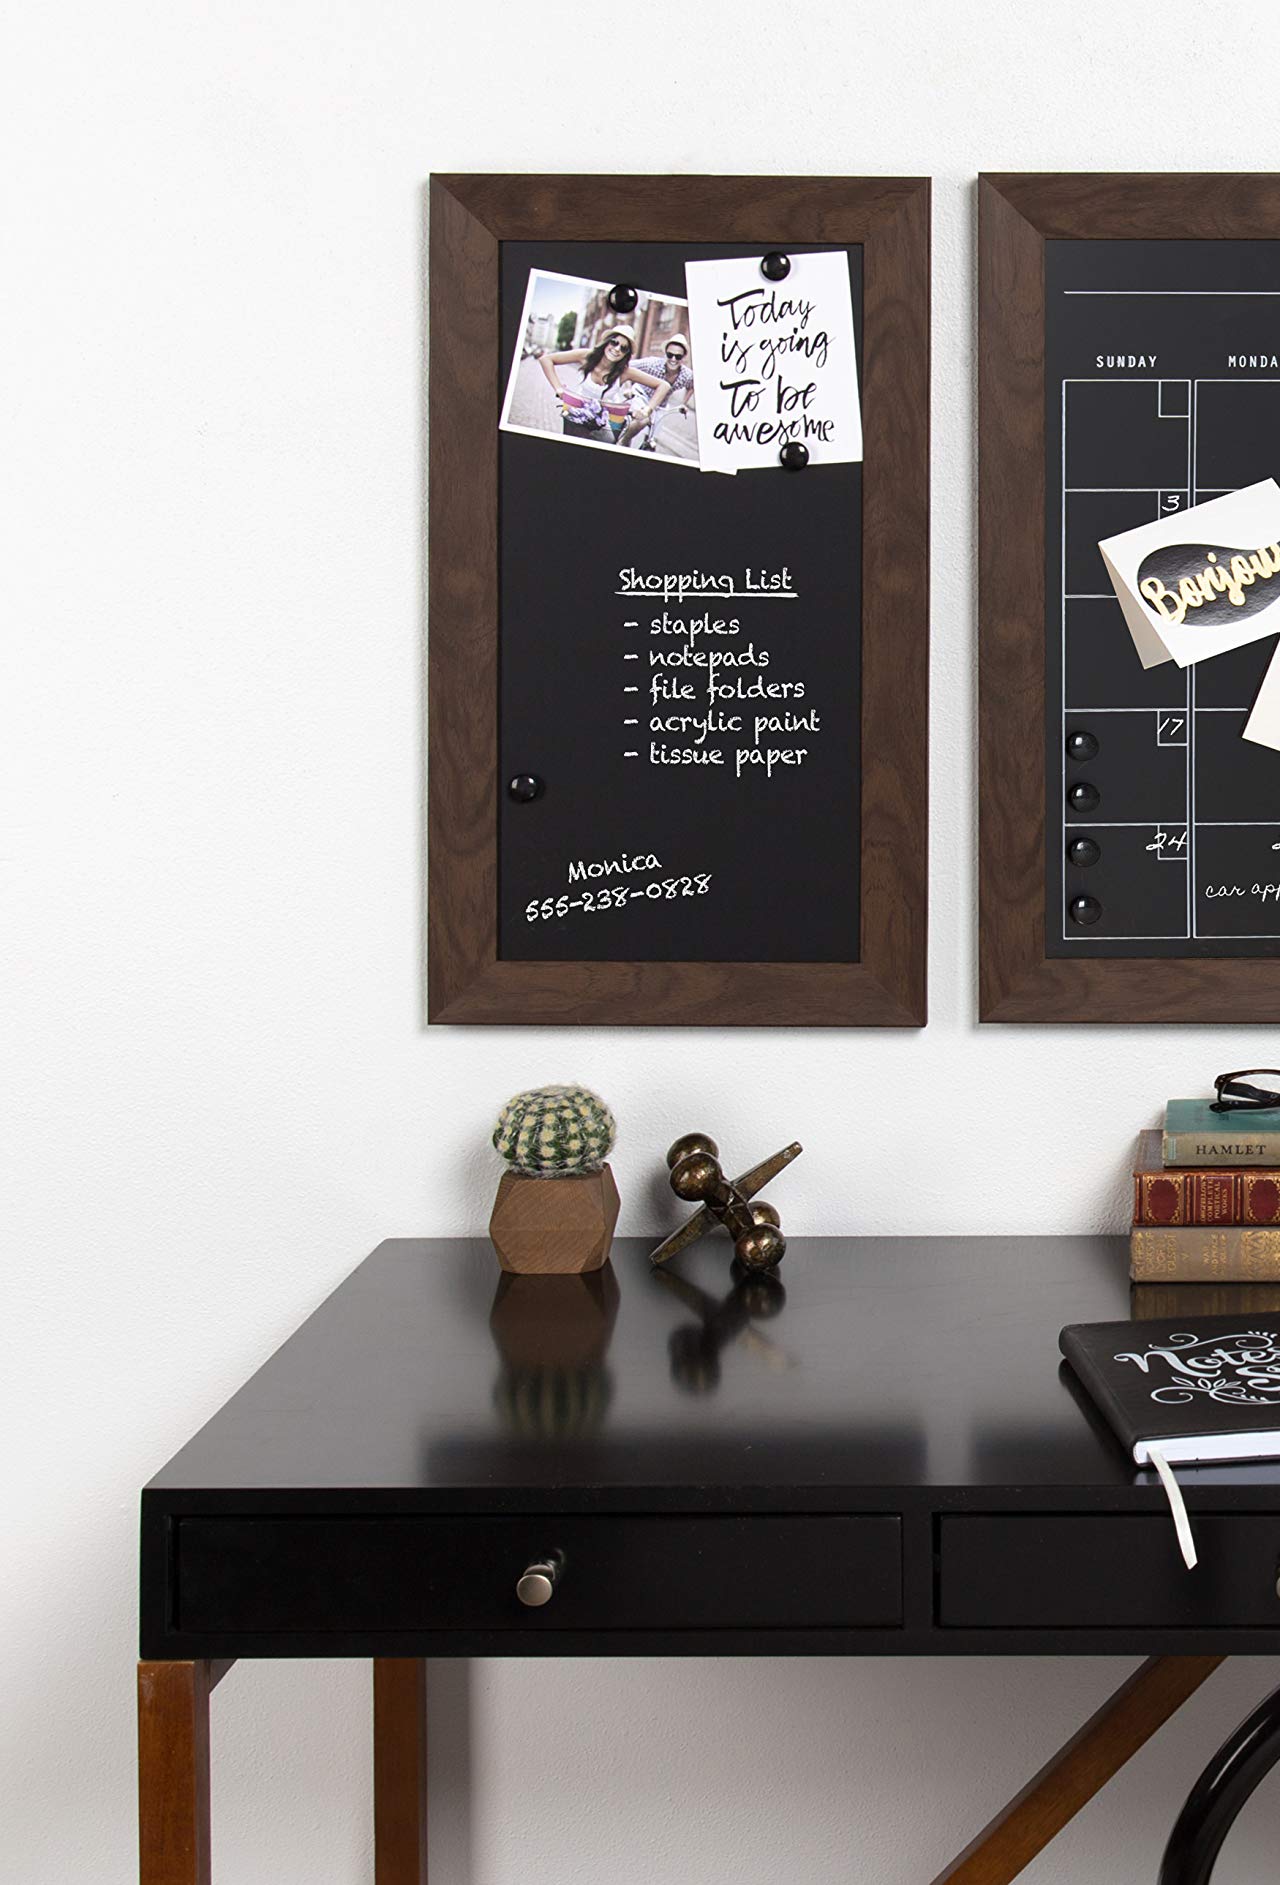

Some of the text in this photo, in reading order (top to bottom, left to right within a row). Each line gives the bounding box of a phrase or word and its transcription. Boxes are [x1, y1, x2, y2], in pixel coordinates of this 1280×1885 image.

[717, 288, 818, 330] Today
[720, 327, 836, 379] is going
[1096, 355, 1158, 368] SUNDAY
[776, 375, 817, 415] be
[713, 414, 836, 446] awesome
[1161, 495, 1180, 512] 3
[619, 567, 793, 603] Shopping List
[650, 611, 740, 647] staples
[649, 643, 770, 681] notepads
[649, 674, 805, 706] file folders
[650, 709, 821, 744] acrylic paint
[1158, 717, 1185, 736] 17
[649, 742, 808, 778] tissue paper
[1145, 831, 1188, 852] 24
[568, 851, 663, 884] Monica
[525, 873, 713, 923] 555-238-0828
[1204, 884, 1246, 899] car
[1195, 1144, 1267, 1156] HAMLET
